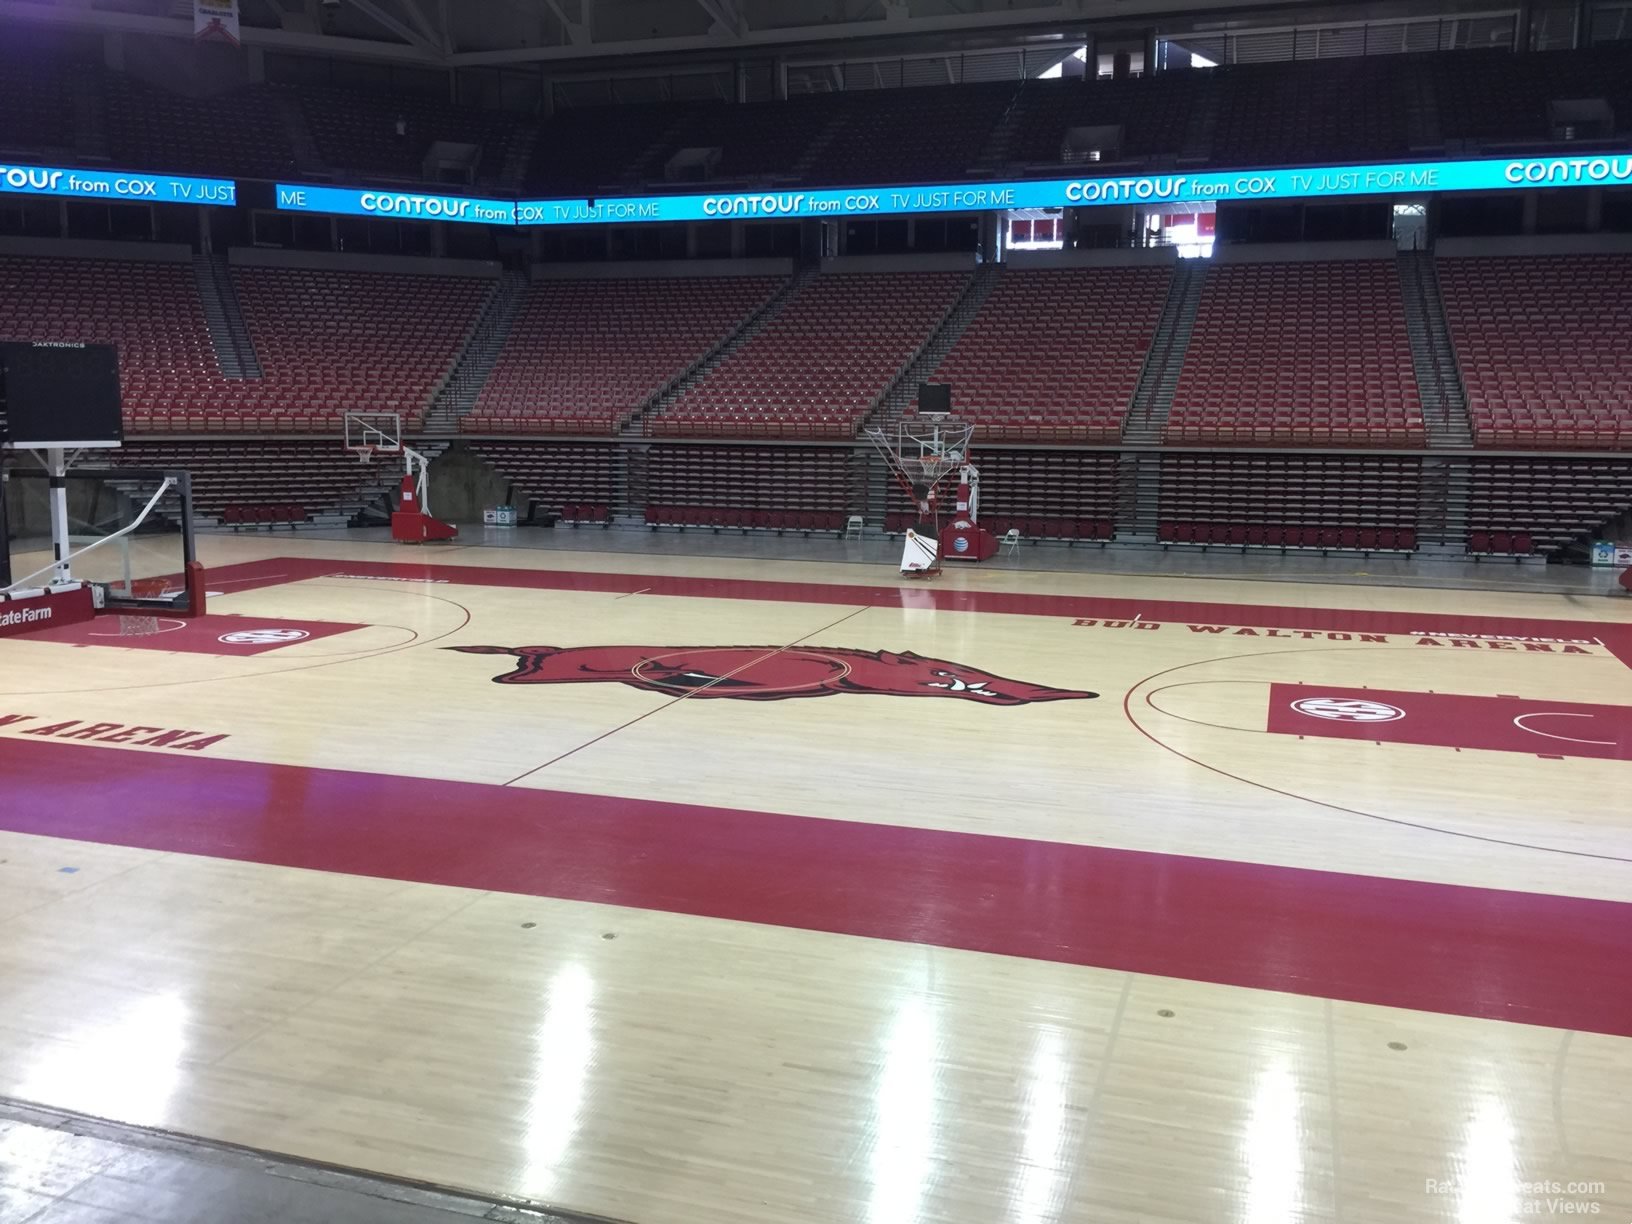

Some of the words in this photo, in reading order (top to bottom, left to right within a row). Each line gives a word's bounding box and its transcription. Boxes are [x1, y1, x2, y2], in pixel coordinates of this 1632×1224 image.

[69, 175, 109, 193] from
[115, 179, 156, 196] COX
[170, 182, 191, 198] TV
[196, 185, 235, 201] JUST
[1191, 181, 1229, 196] from
[1235, 177, 1275, 194] COX
[1290, 175, 1313, 191] TV
[1317, 172, 1359, 191] JUST
[1365, 170, 1405, 188] FOR
[1410, 169, 1439, 186] ME
[281, 191, 307, 206] ME
[475, 205, 507, 220] from
[511, 206, 543, 221] COX
[554, 206, 570, 219] TV
[573, 204, 603, 219] JUST
[607, 203, 636, 217] FOR
[639, 202, 659, 216] ME
[808, 199, 841, 212] from
[845, 195, 879, 210] COX
[891, 193, 909, 208] TV
[913, 192, 949, 208] JUST
[954, 190, 986, 206] FOR
[990, 189, 1015, 205] ME
[1071, 619, 1161, 631] BUD
[1187, 624, 1389, 644] WALTON
[1415, 637, 1594, 655] ARENA
[19, 720, 232, 751] ARENA
